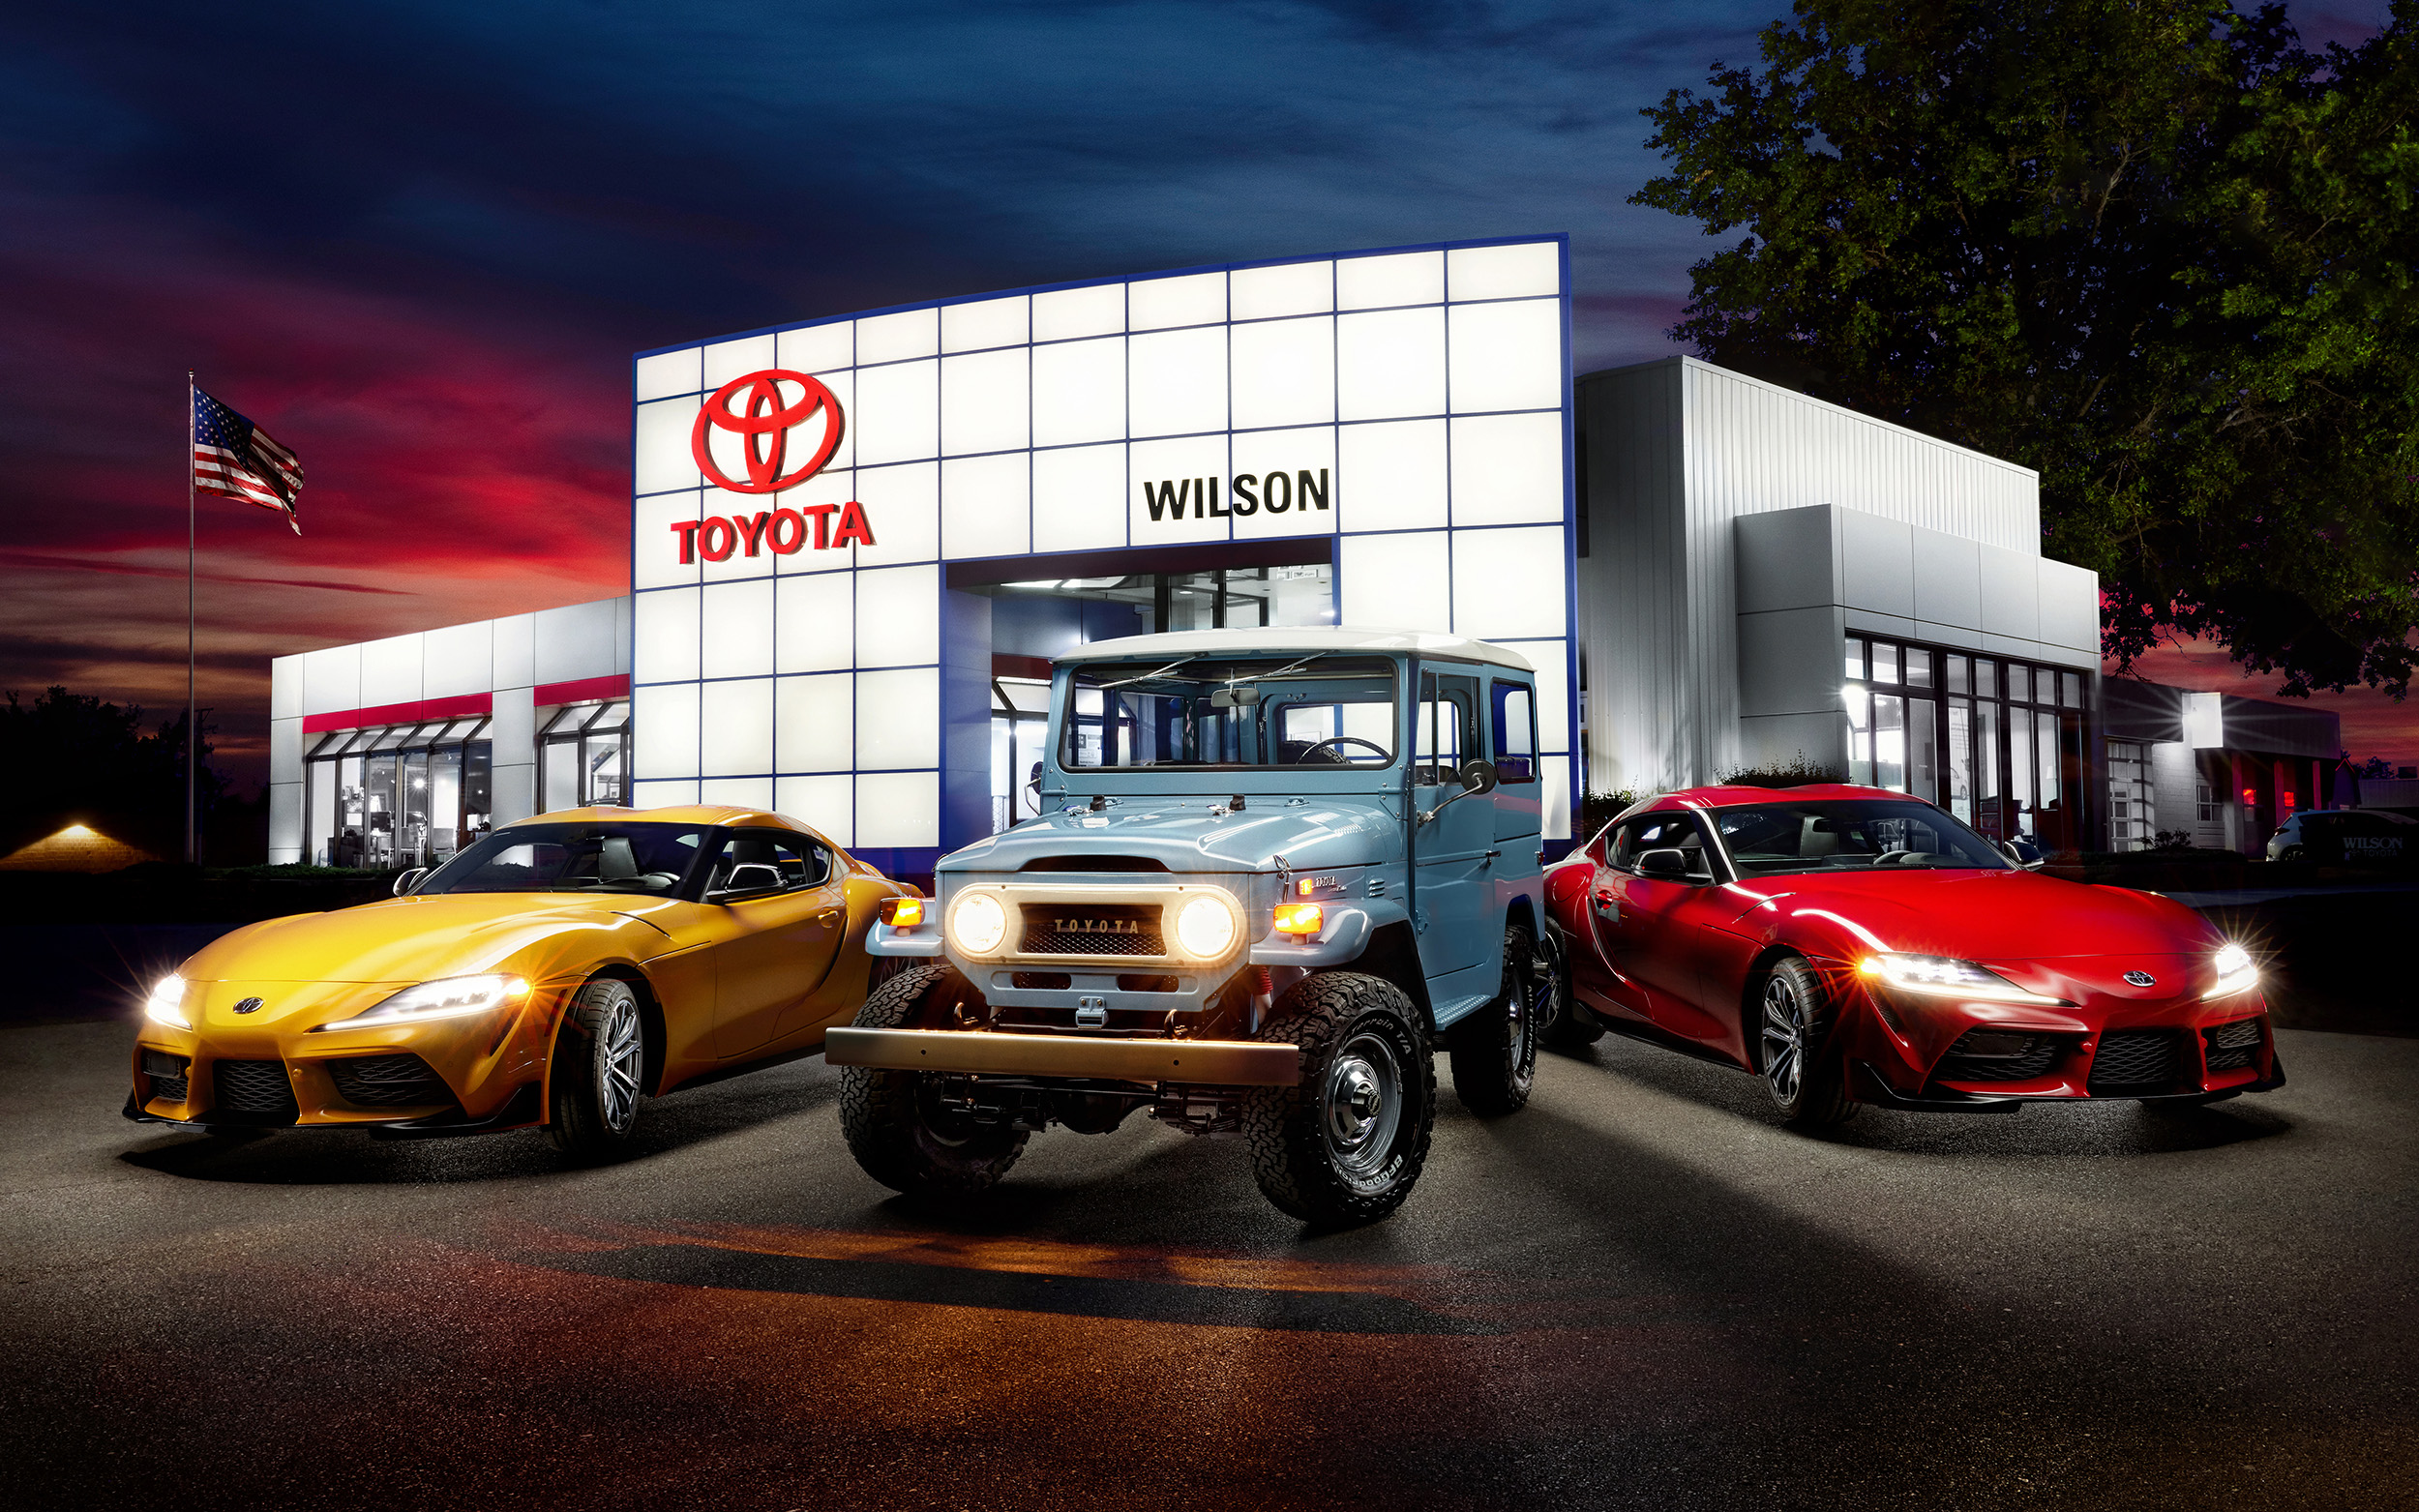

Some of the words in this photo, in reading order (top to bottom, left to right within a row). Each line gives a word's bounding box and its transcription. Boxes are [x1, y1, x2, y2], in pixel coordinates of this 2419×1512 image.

[1144, 468, 1330, 522] WILSON
[671, 500, 877, 565] TOYOTA
[2343, 837, 2404, 849] WILSON
[1055, 919, 1139, 934] TOYOTA
[1395, 1030, 1412, 1055] T/A
